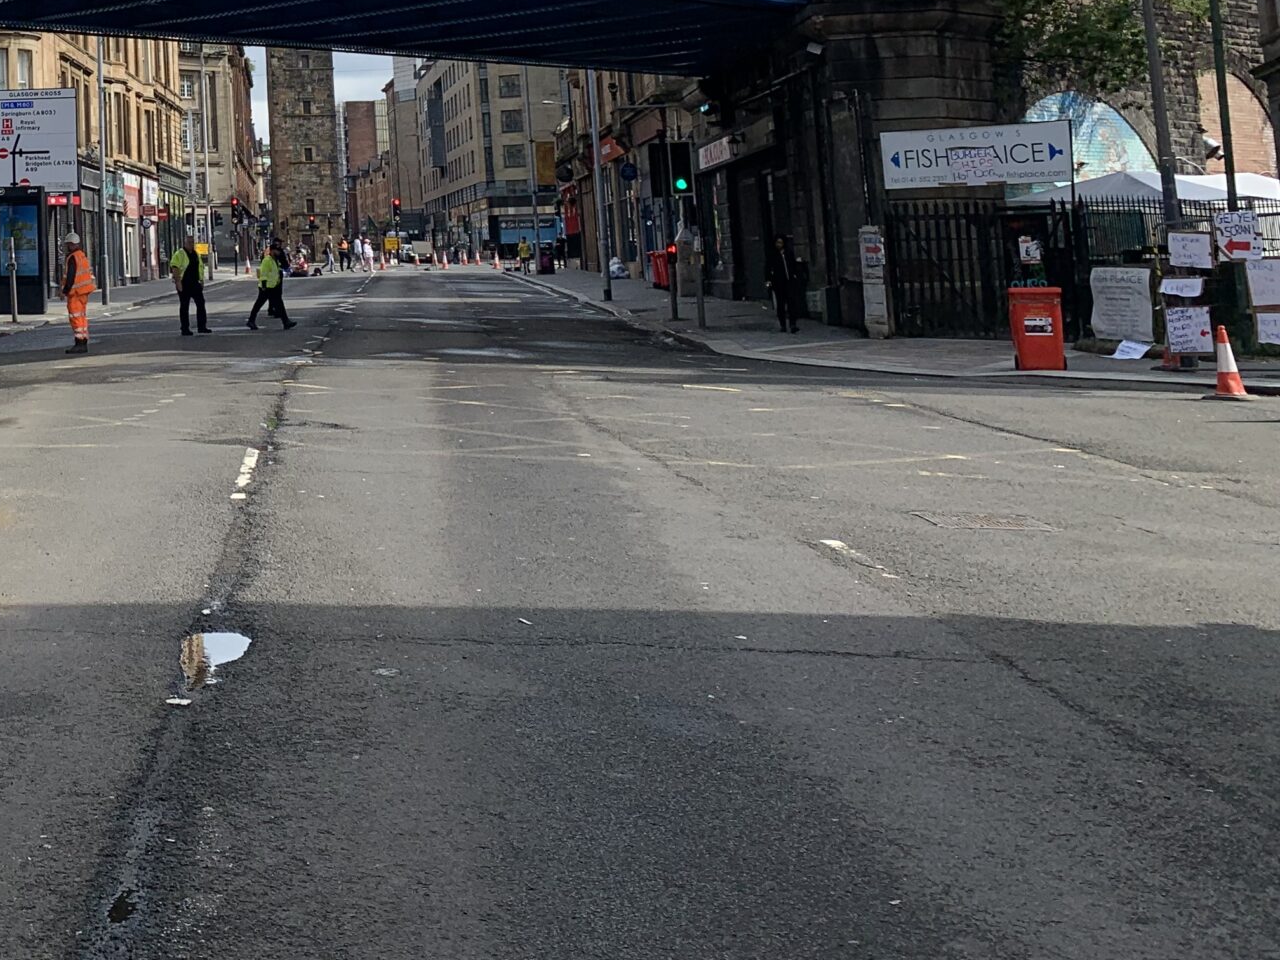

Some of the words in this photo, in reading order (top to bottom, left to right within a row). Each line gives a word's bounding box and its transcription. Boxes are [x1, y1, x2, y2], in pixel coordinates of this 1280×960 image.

[927, 130, 1004, 143] GLASGOW
[951, 147, 993, 161] BURGER
[951, 158, 993, 171] CHIPS
